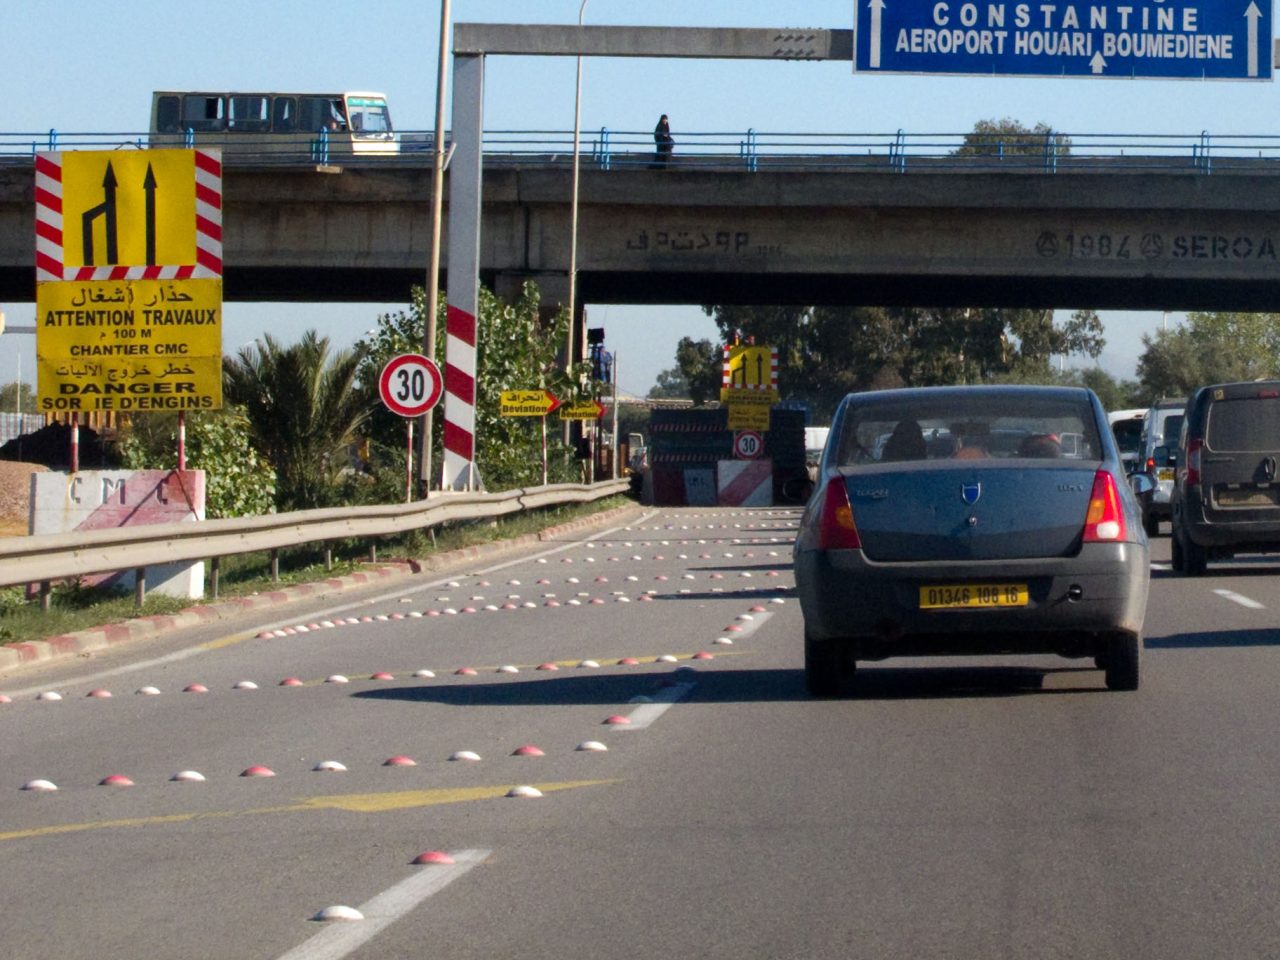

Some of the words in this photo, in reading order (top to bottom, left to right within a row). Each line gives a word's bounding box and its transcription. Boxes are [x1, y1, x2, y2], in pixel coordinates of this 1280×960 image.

[933, 2, 1198, 32] CONSTANTINE
[896, 28, 1007, 54] AEROPORT
[1015, 30, 1091, 57] HOUARI
[1103, 33, 1233, 59] BOUMEDIENE
[1067, 234, 1131, 259] 1984
[1172, 235, 1277, 259] SEROA
[144, 285, 193, 306] حذار
[45, 310, 134, 326] ATTENTION
[143, 309, 216, 325] TRAVAUX
[113, 329, 136, 338] 100
[141, 329, 152, 338] M
[71, 344, 149, 356] CHANTIER
[155, 343, 188, 354] CMC
[107, 365, 151, 381] خروج
[156, 363, 195, 379] خطر
[60, 383, 196, 394] DANGER
[397, 369, 425, 401] 30
[120, 396, 213, 409] D'ENGINS
[742, 438, 755, 453] 30
[976, 586, 999, 604] 108
[1004, 586, 1018, 603] 16
